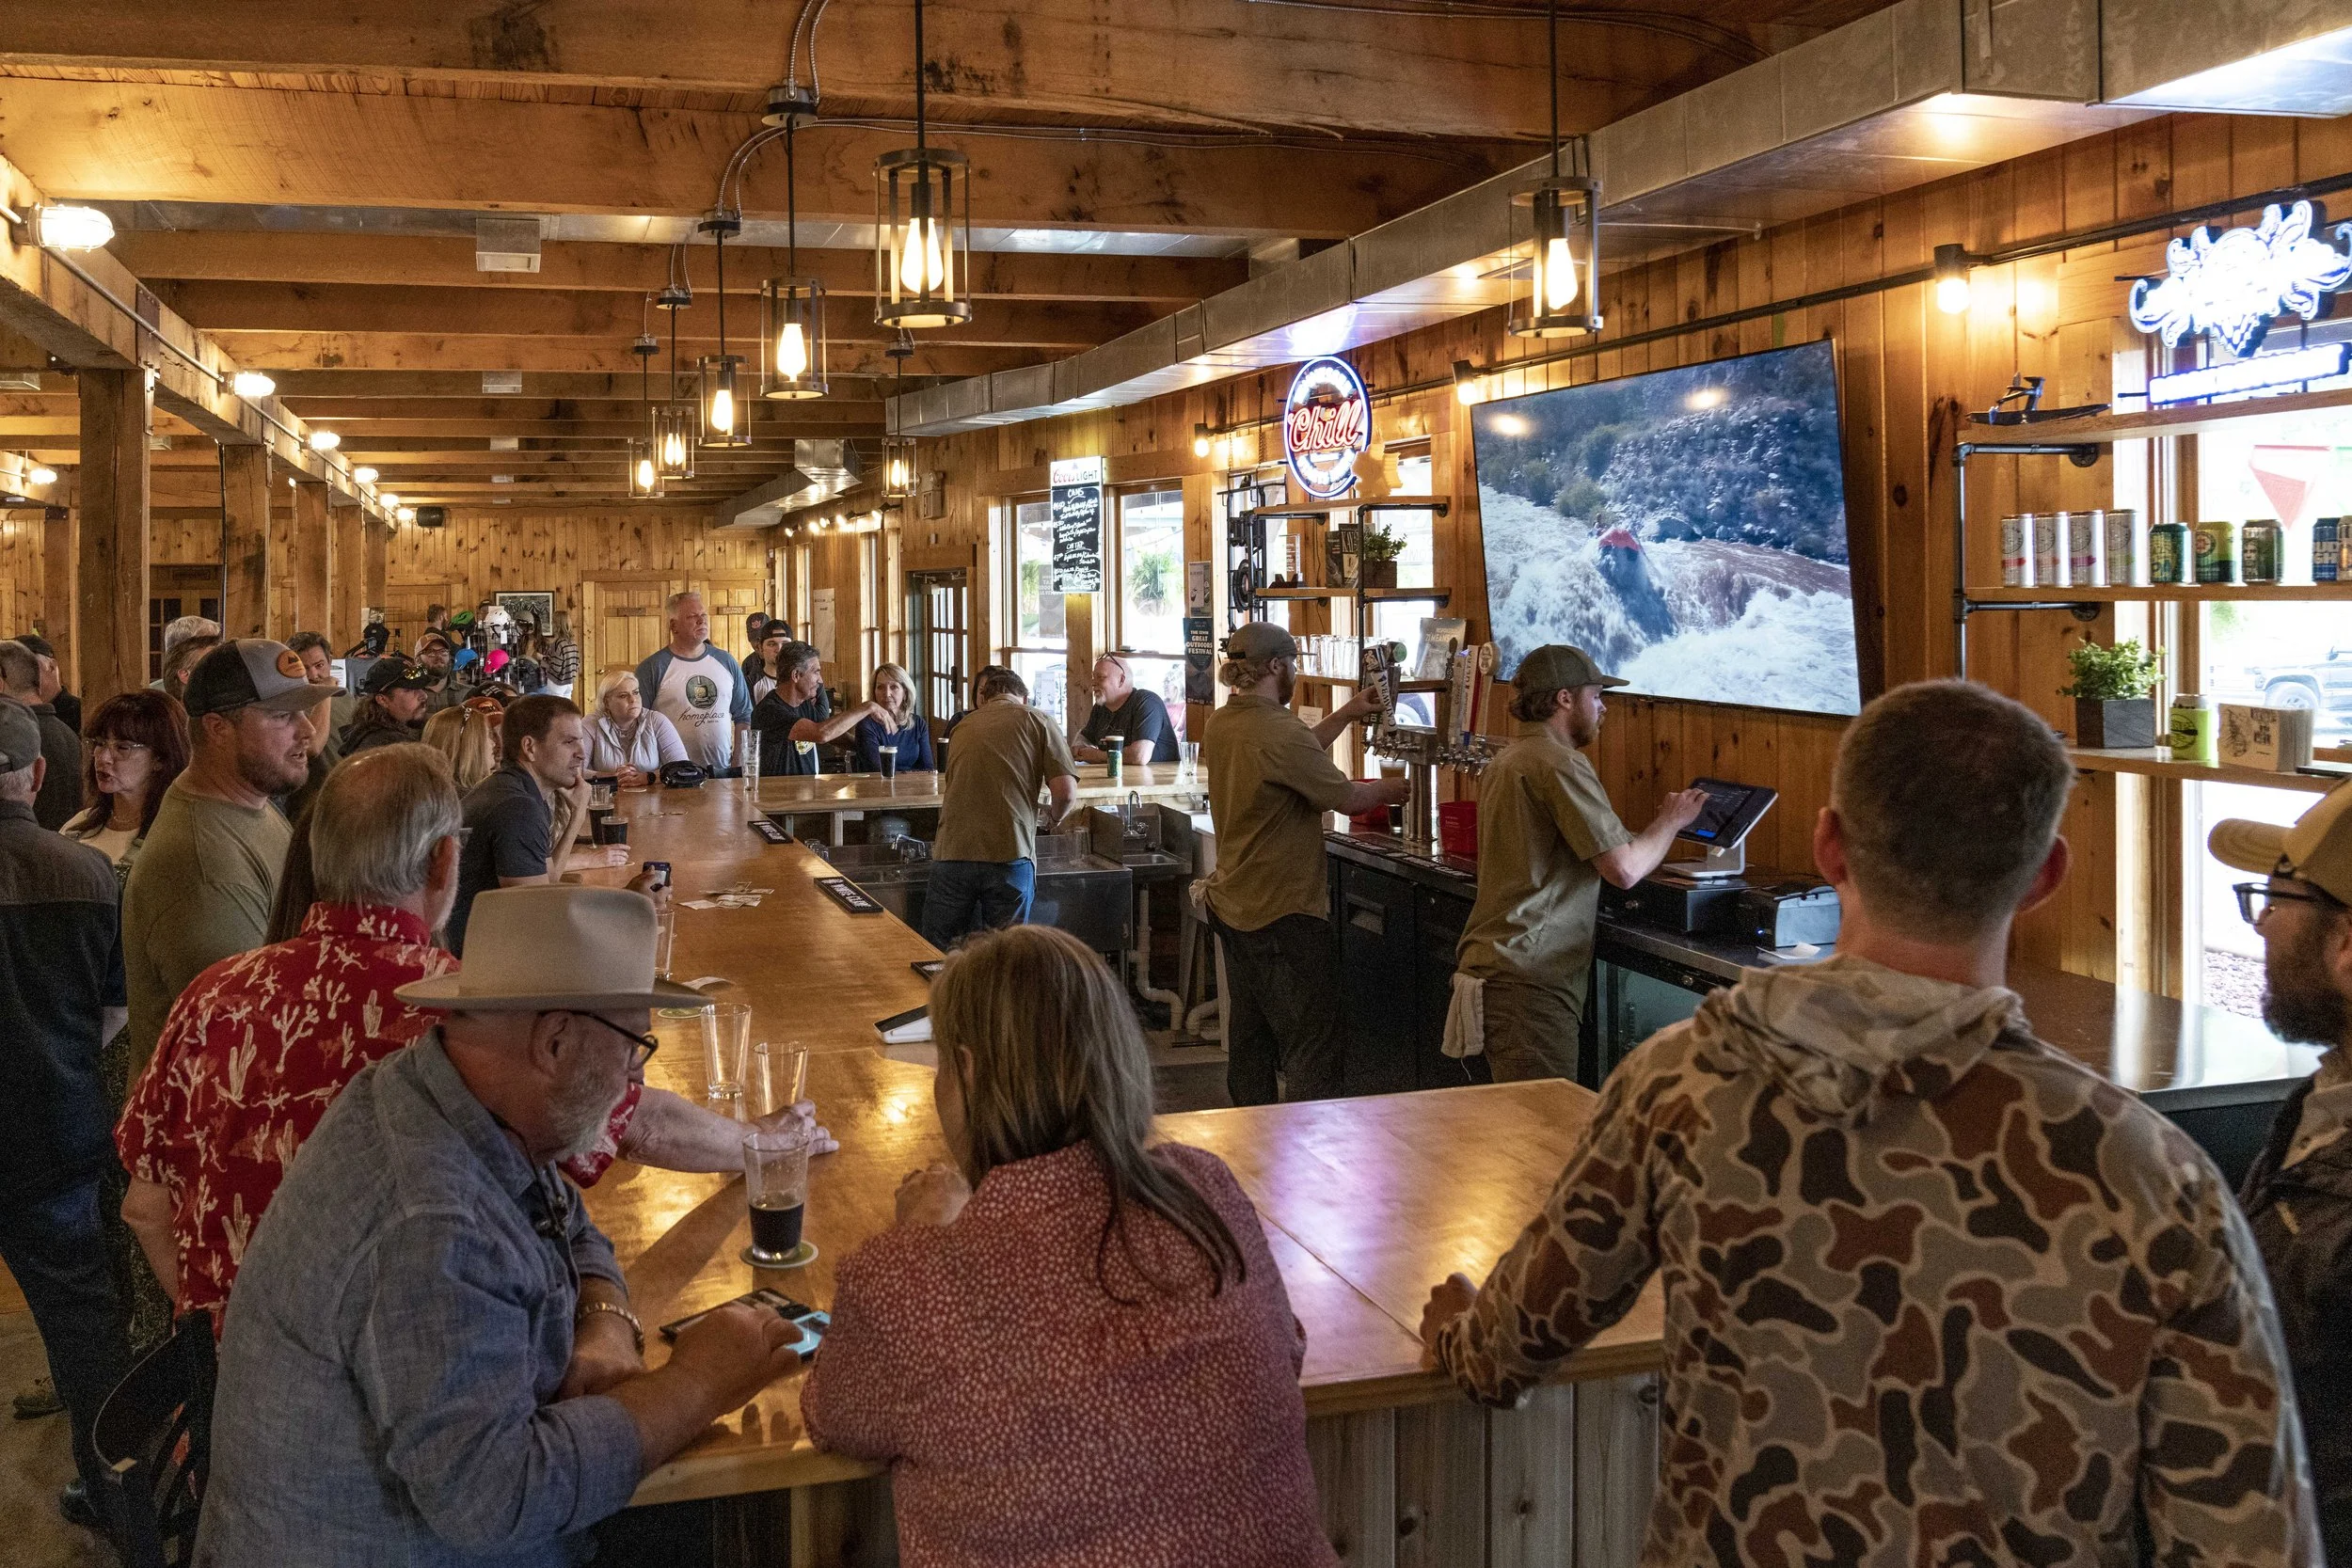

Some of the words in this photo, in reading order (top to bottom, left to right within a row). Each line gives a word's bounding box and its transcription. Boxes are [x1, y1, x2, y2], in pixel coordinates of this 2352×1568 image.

[1287, 399, 1363, 452] Chill
[1053, 469, 1075, 483] Coors
[1076, 470, 1098, 482] LIGHT
[2312, 542, 2339, 552] UD
[1379, 681, 1396, 727] CATAWBA
[678, 706, 724, 727] homeplace
